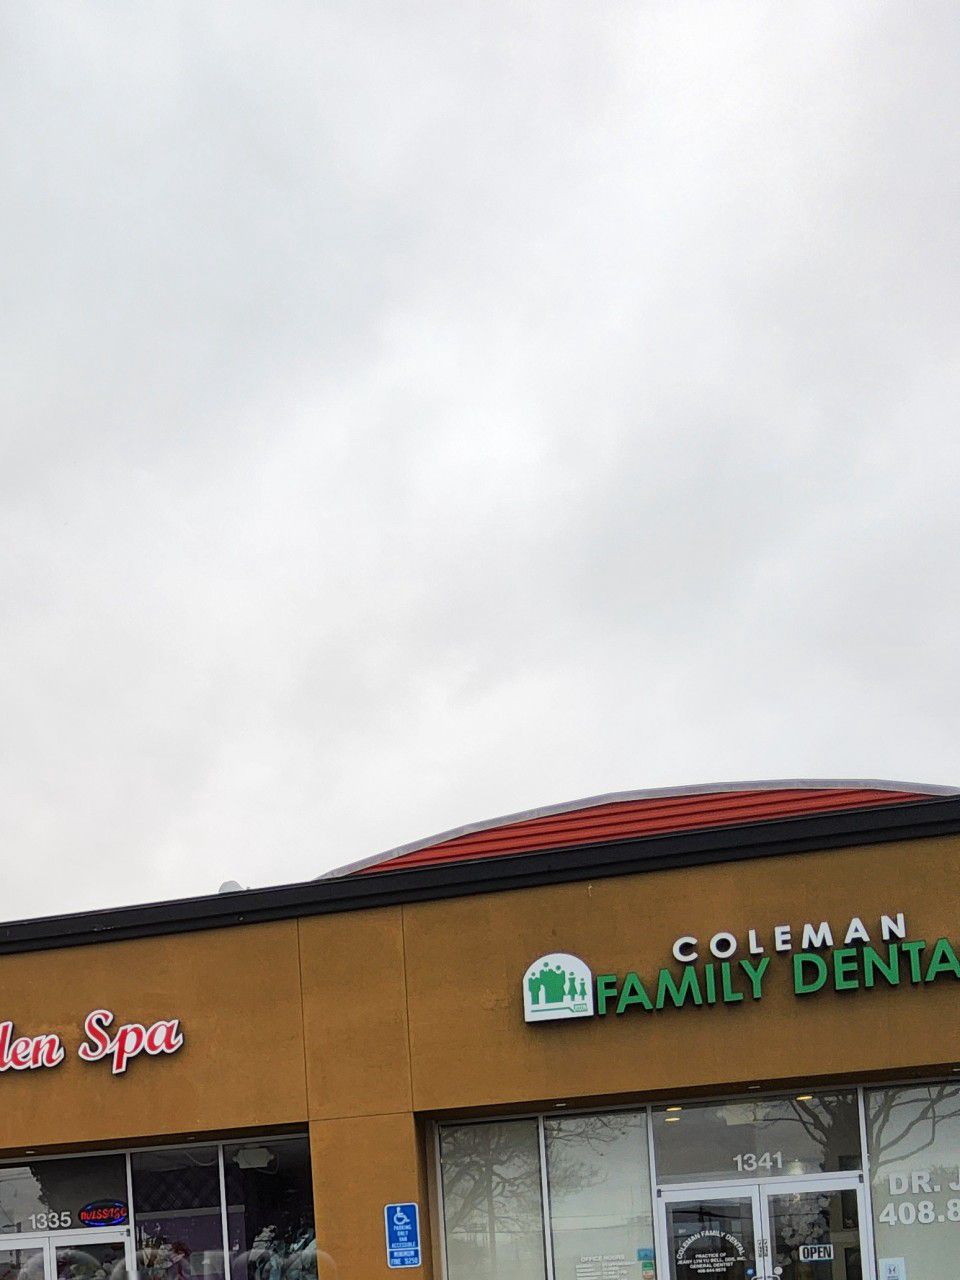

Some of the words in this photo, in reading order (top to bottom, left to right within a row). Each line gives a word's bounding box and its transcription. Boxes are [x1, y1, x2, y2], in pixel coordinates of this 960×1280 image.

[672, 912, 907, 964] COLEMAN
[596, 956, 771, 1015] FAMILY
[78, 1009, 184, 1075] Spa
[732, 1150, 783, 1172] 1341
[888, 1169, 942, 1195] DR.
[28, 1211, 72, 1230] 1335
[878, 1198, 960, 1226] 408.8
[677, 1233, 700, 1259] COLEMAN
[726, 1234, 745, 1255] DENTAL
[802, 1246, 832, 1259] OPEN
